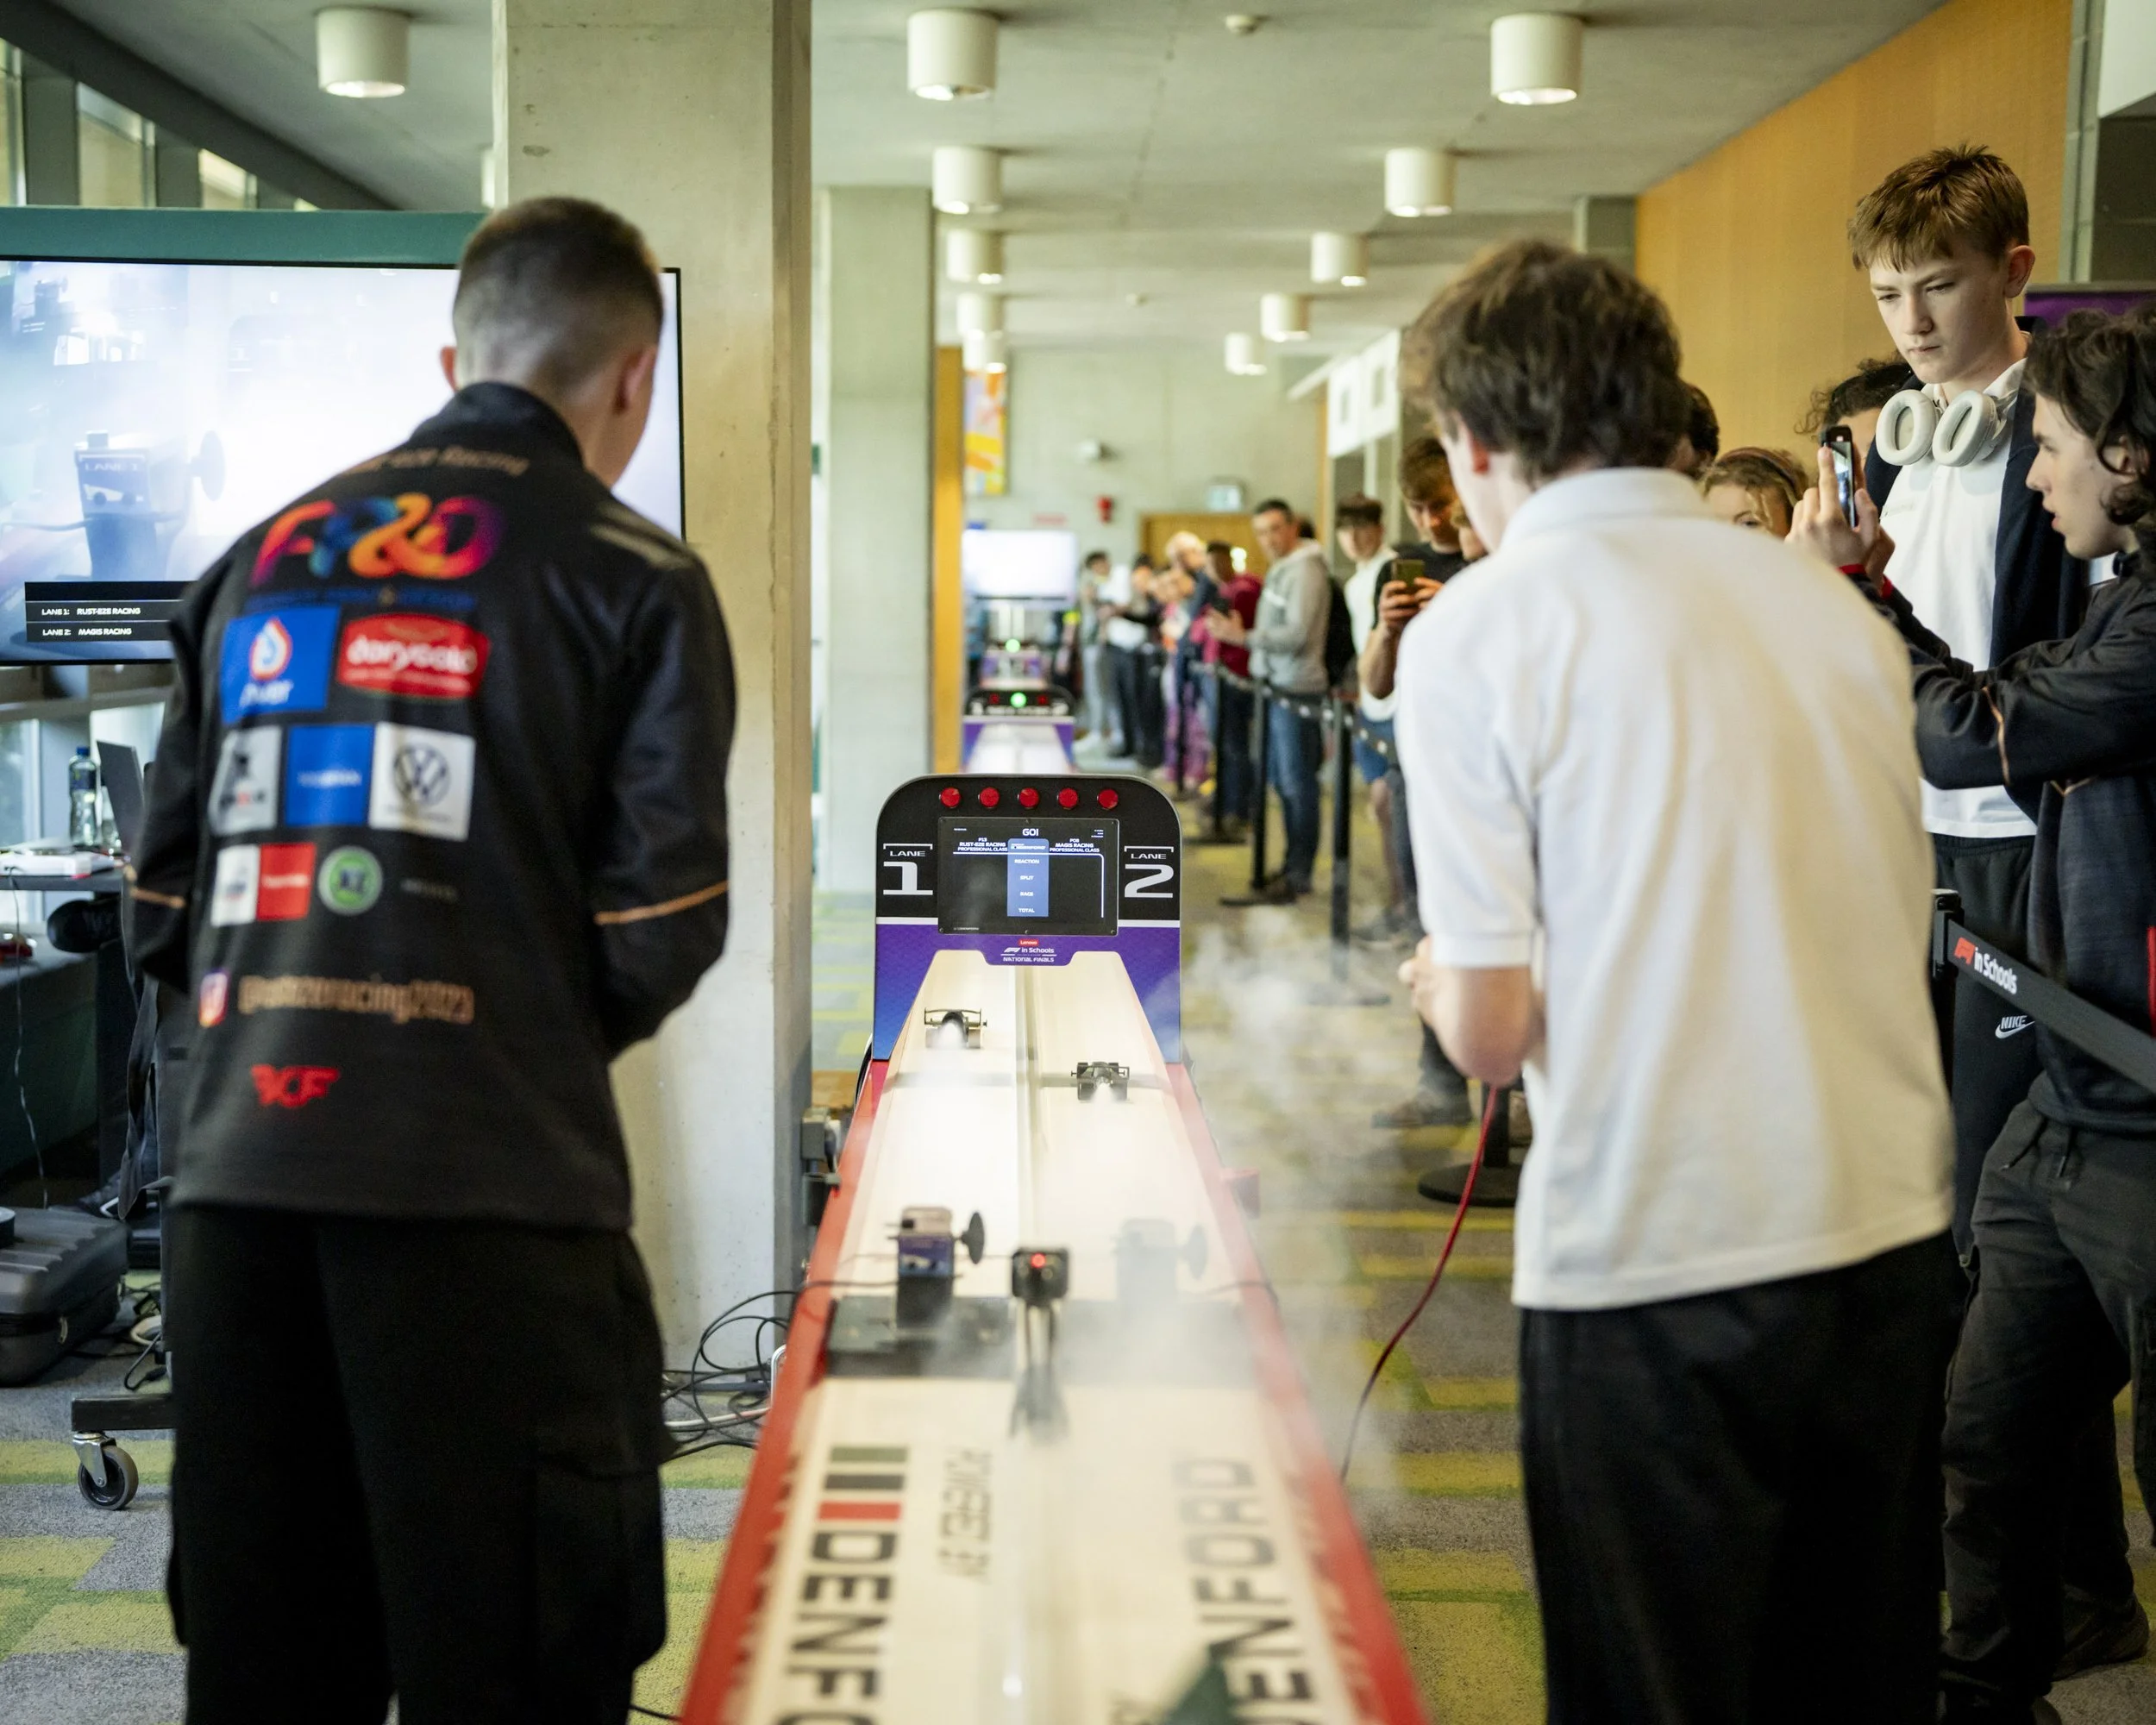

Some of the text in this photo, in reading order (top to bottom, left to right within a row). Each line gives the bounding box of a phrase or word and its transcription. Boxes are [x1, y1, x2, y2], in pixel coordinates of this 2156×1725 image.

[883, 861, 933, 896] 1
[1124, 863, 1175, 899] 2
[1974, 946, 1984, 973] in
[1984, 952, 2018, 995] Schools
[2000, 1014, 2028, 1029] NIKE
[1171, 1458, 1326, 1725] ENFORD
